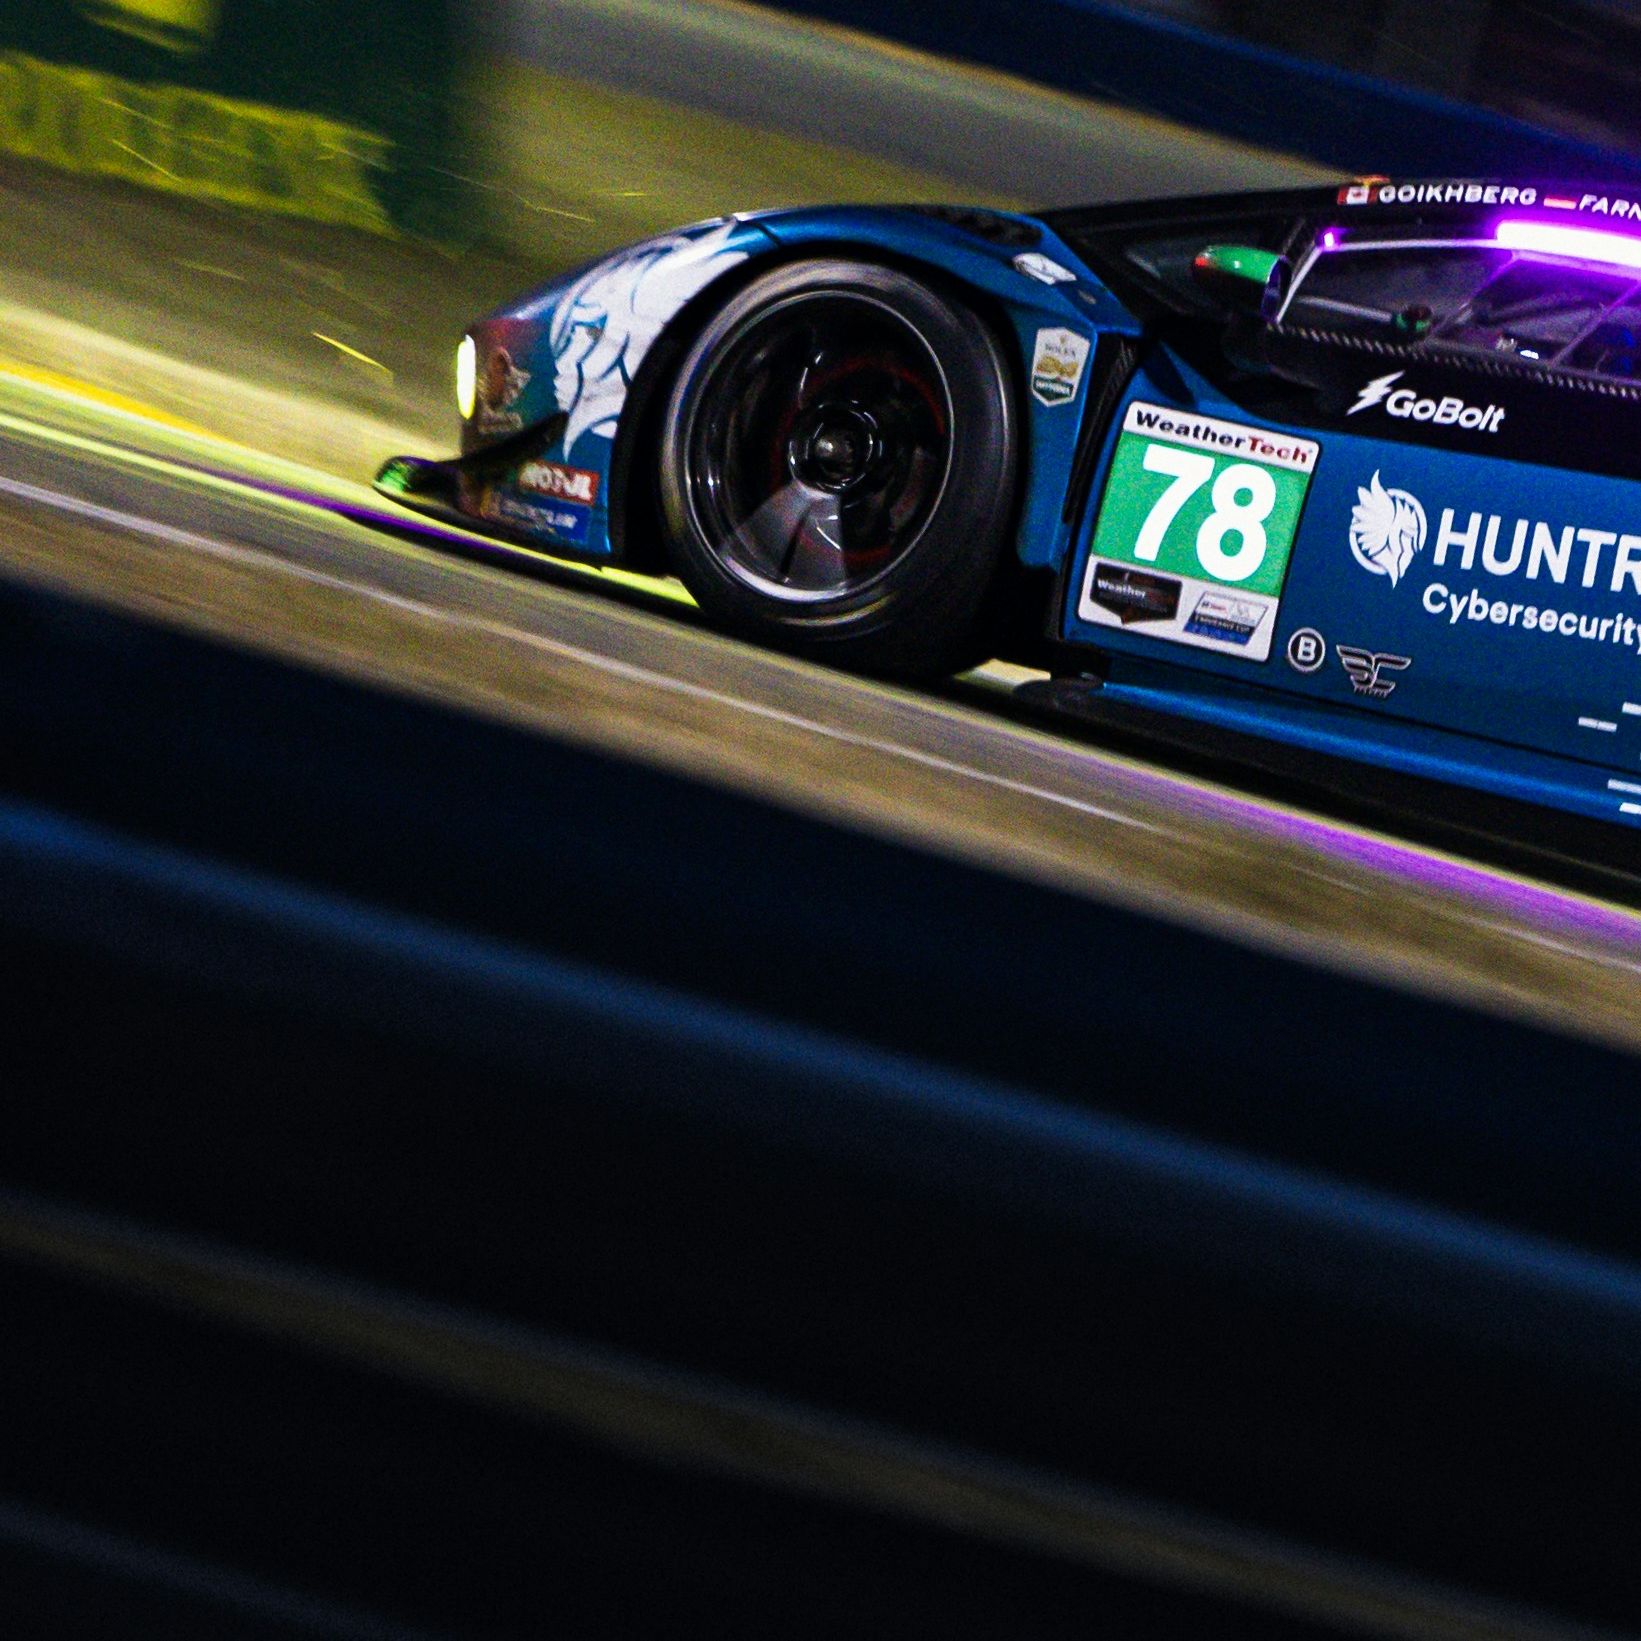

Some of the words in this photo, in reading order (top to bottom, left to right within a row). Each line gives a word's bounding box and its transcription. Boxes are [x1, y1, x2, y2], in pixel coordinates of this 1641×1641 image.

[1377, 184, 1537, 206] GOIKHBERG
[1135, 408, 1308, 464] WeatherTech
[1385, 388, 1506, 434] GoBolt
[1133, 443, 1277, 582] 78
